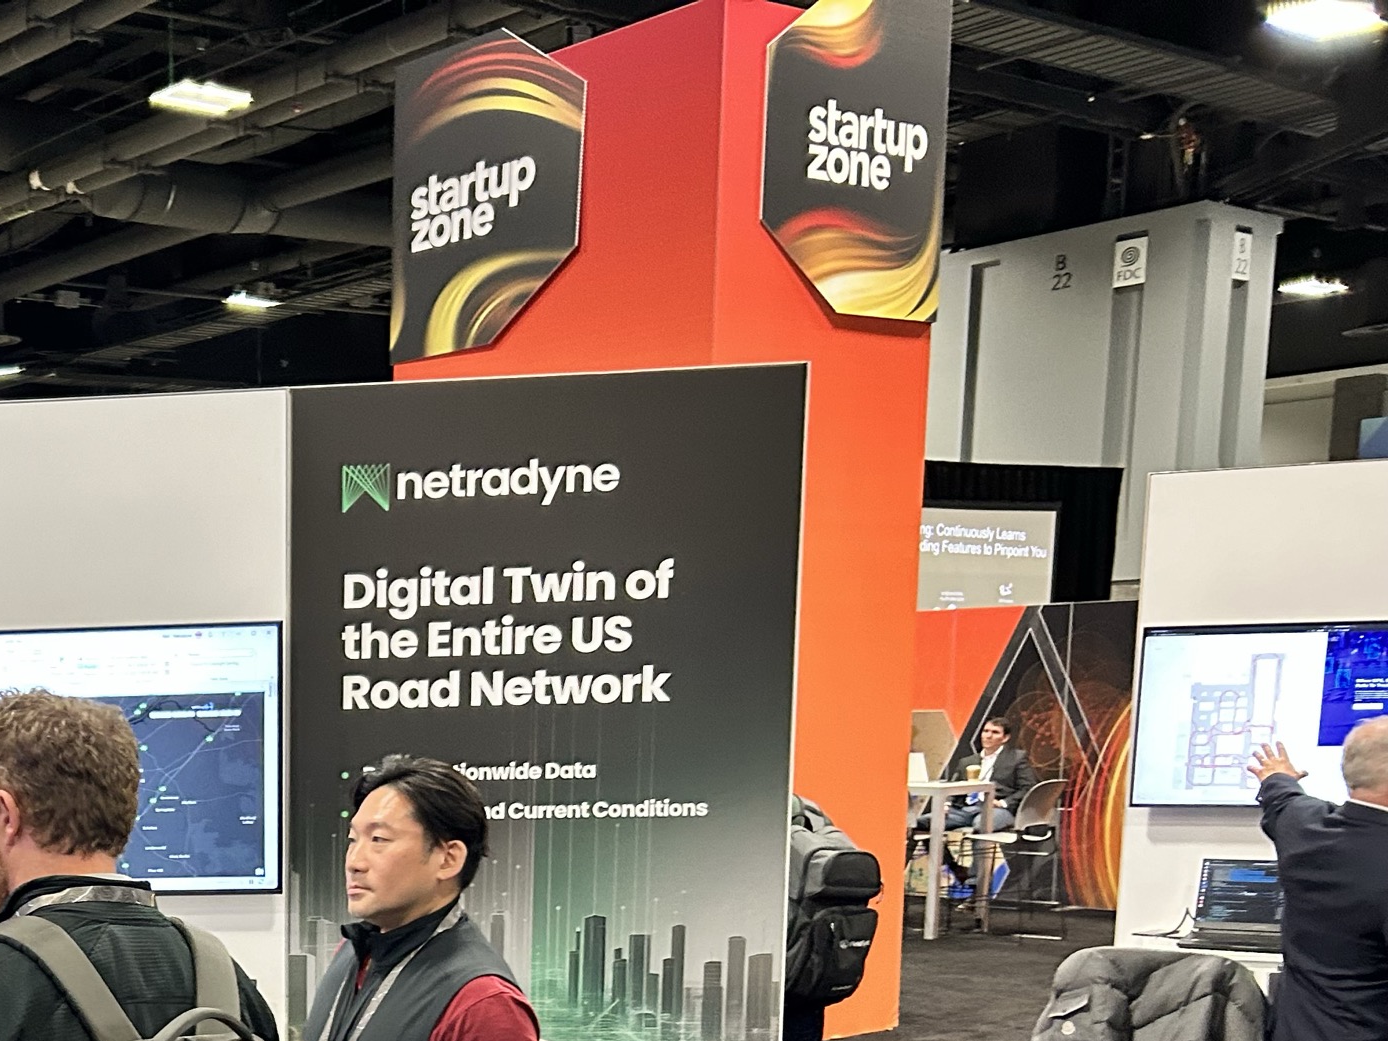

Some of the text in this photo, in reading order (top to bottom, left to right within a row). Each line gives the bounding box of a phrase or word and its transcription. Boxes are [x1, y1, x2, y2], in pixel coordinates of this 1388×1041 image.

[808, 99, 928, 173] startup
[411, 156, 536, 219] startup
[807, 144, 891, 190] zone
[411, 202, 494, 253] zone
[1051, 273, 1072, 290] 22
[1055, 254, 1066, 271] B
[1235, 259, 1248, 275] 22
[397, 458, 621, 506] netradyne
[919, 539, 1047, 559] ding Features to Pinpoint You
[920, 523, 1027, 542] ng: Continuously Learns
[343, 558, 675, 620] Digital Twin of
[341, 615, 633, 660] the Entire US
[342, 665, 672, 710] Road Network
[452, 761, 597, 781] ionwide Data
[508, 801, 590, 820] Current
[592, 798, 709, 819] Conditions
